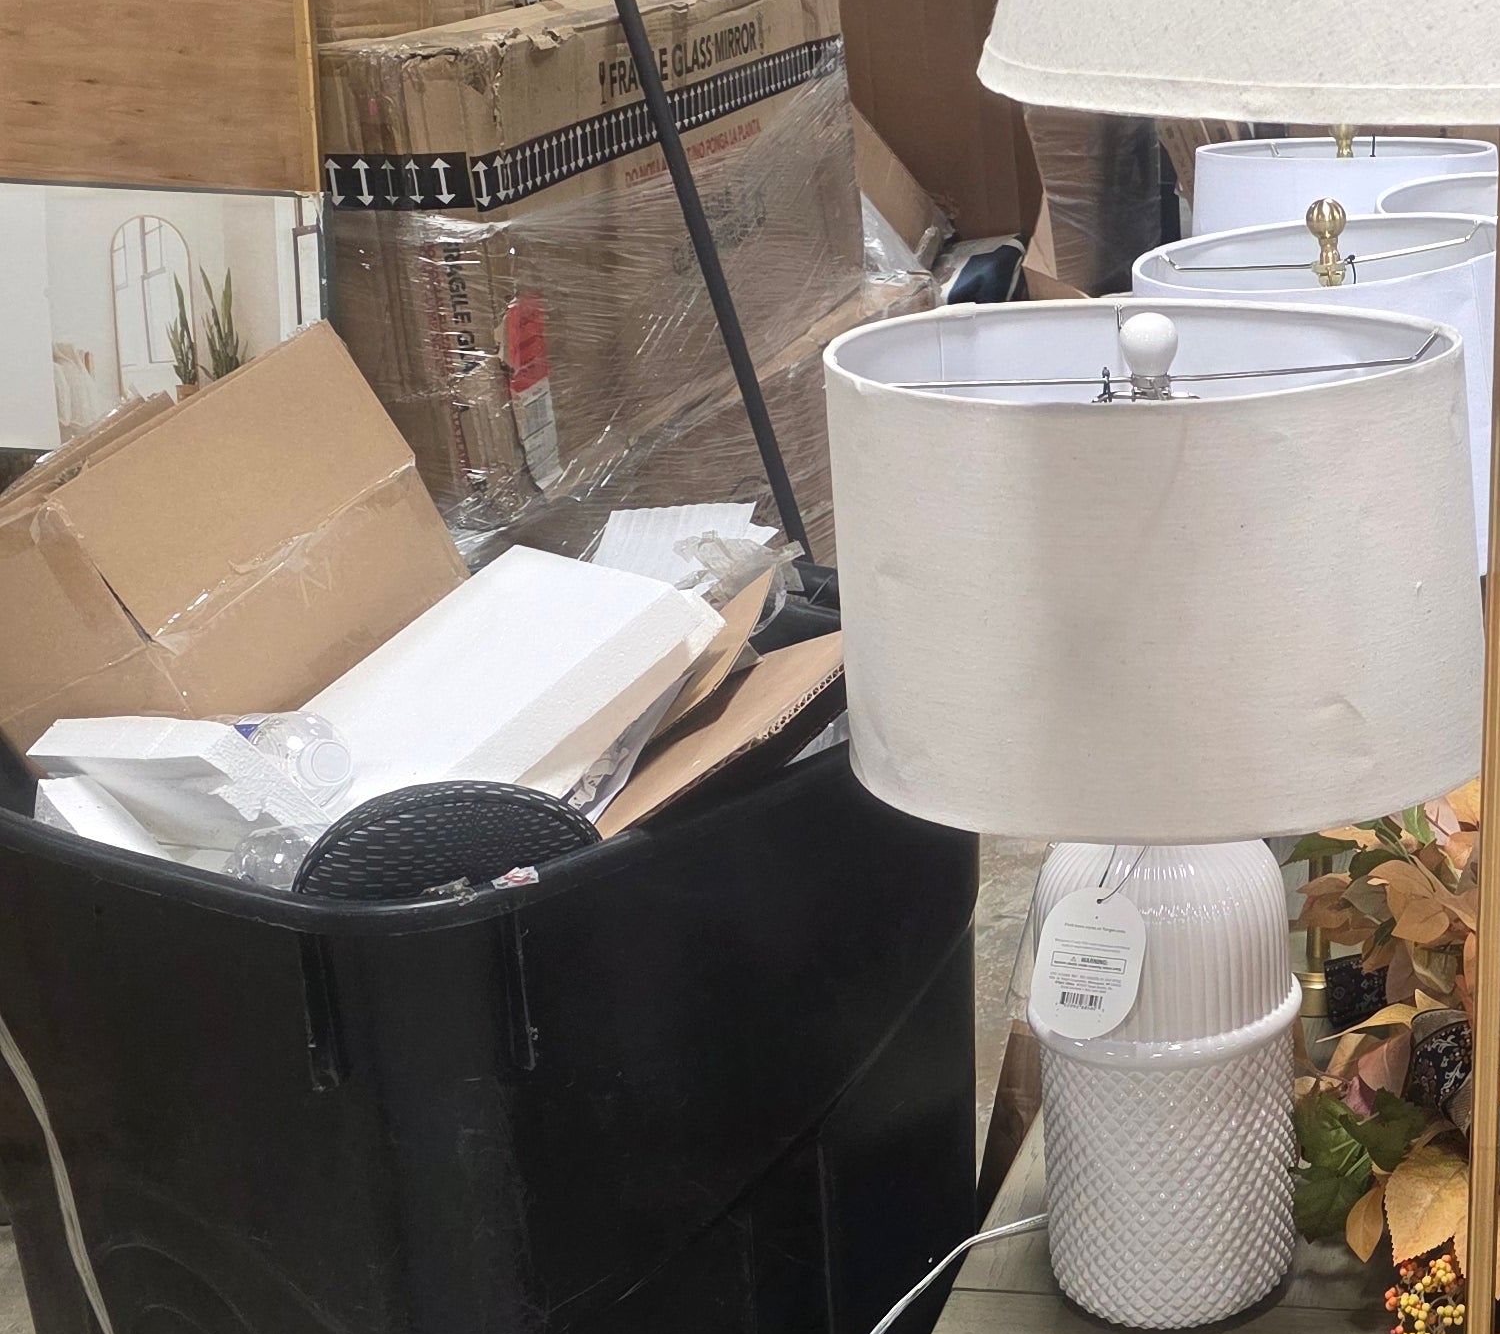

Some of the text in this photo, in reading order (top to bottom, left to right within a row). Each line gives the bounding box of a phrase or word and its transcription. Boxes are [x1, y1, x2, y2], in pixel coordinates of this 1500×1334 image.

[609, 21, 757, 98] FRAE GLASS MIRROR
